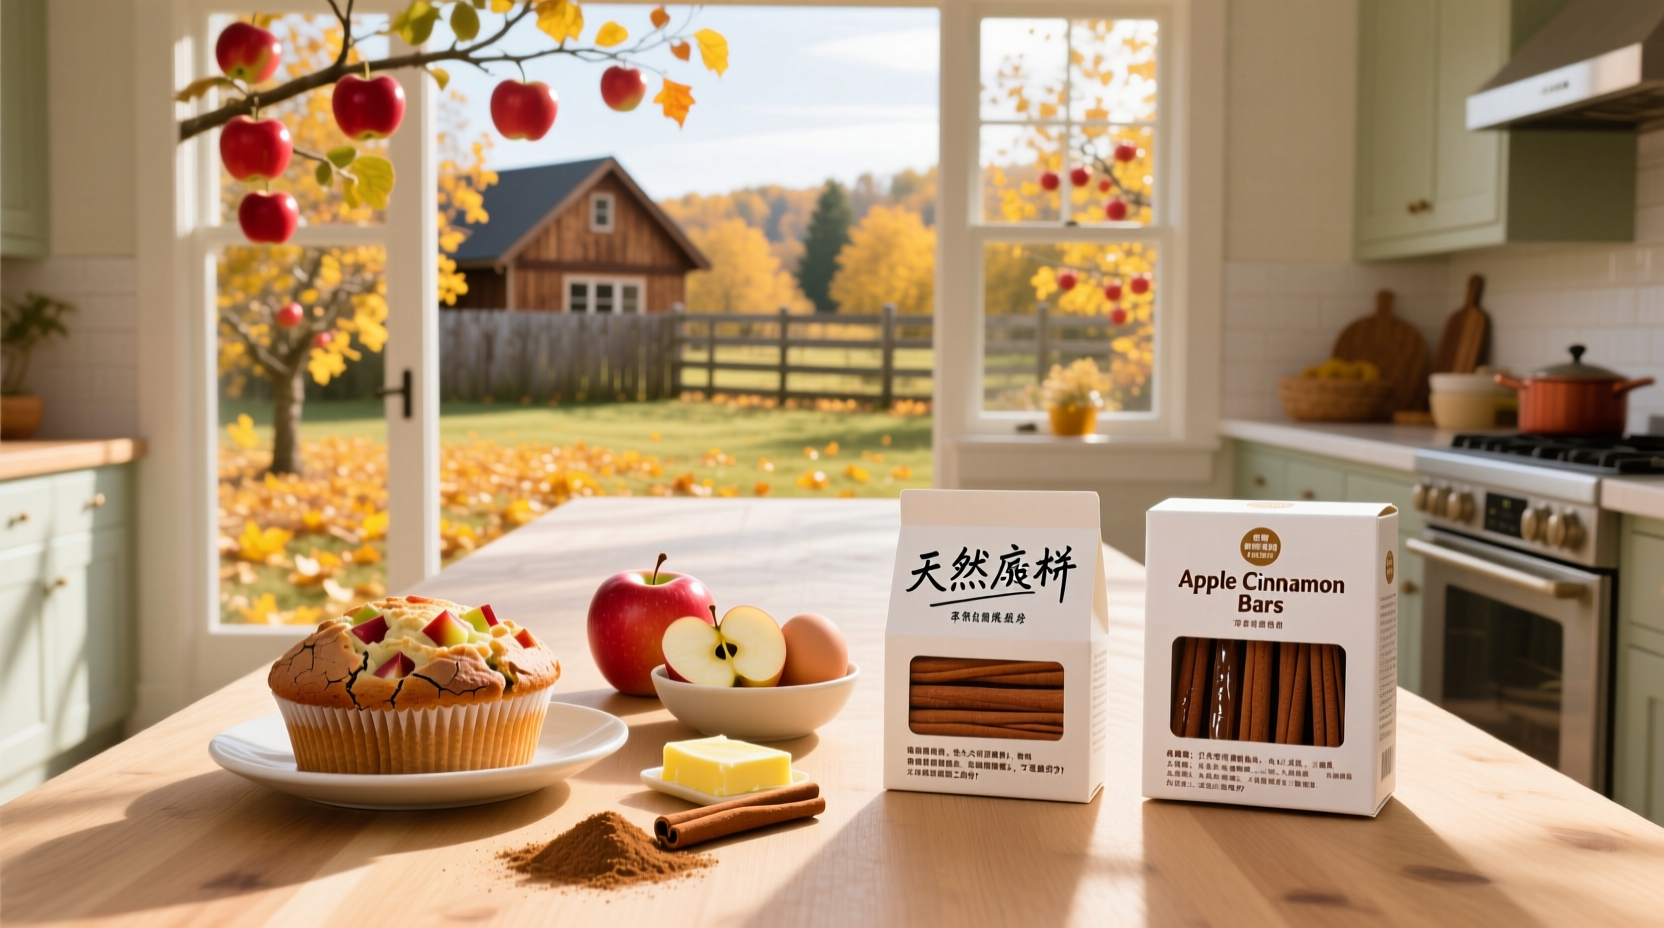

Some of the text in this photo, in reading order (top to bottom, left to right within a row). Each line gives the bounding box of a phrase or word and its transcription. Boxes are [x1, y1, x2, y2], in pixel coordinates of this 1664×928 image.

[1178, 569, 1345, 595] Apple Cinnamon
[1238, 594, 1284, 614] Bars
